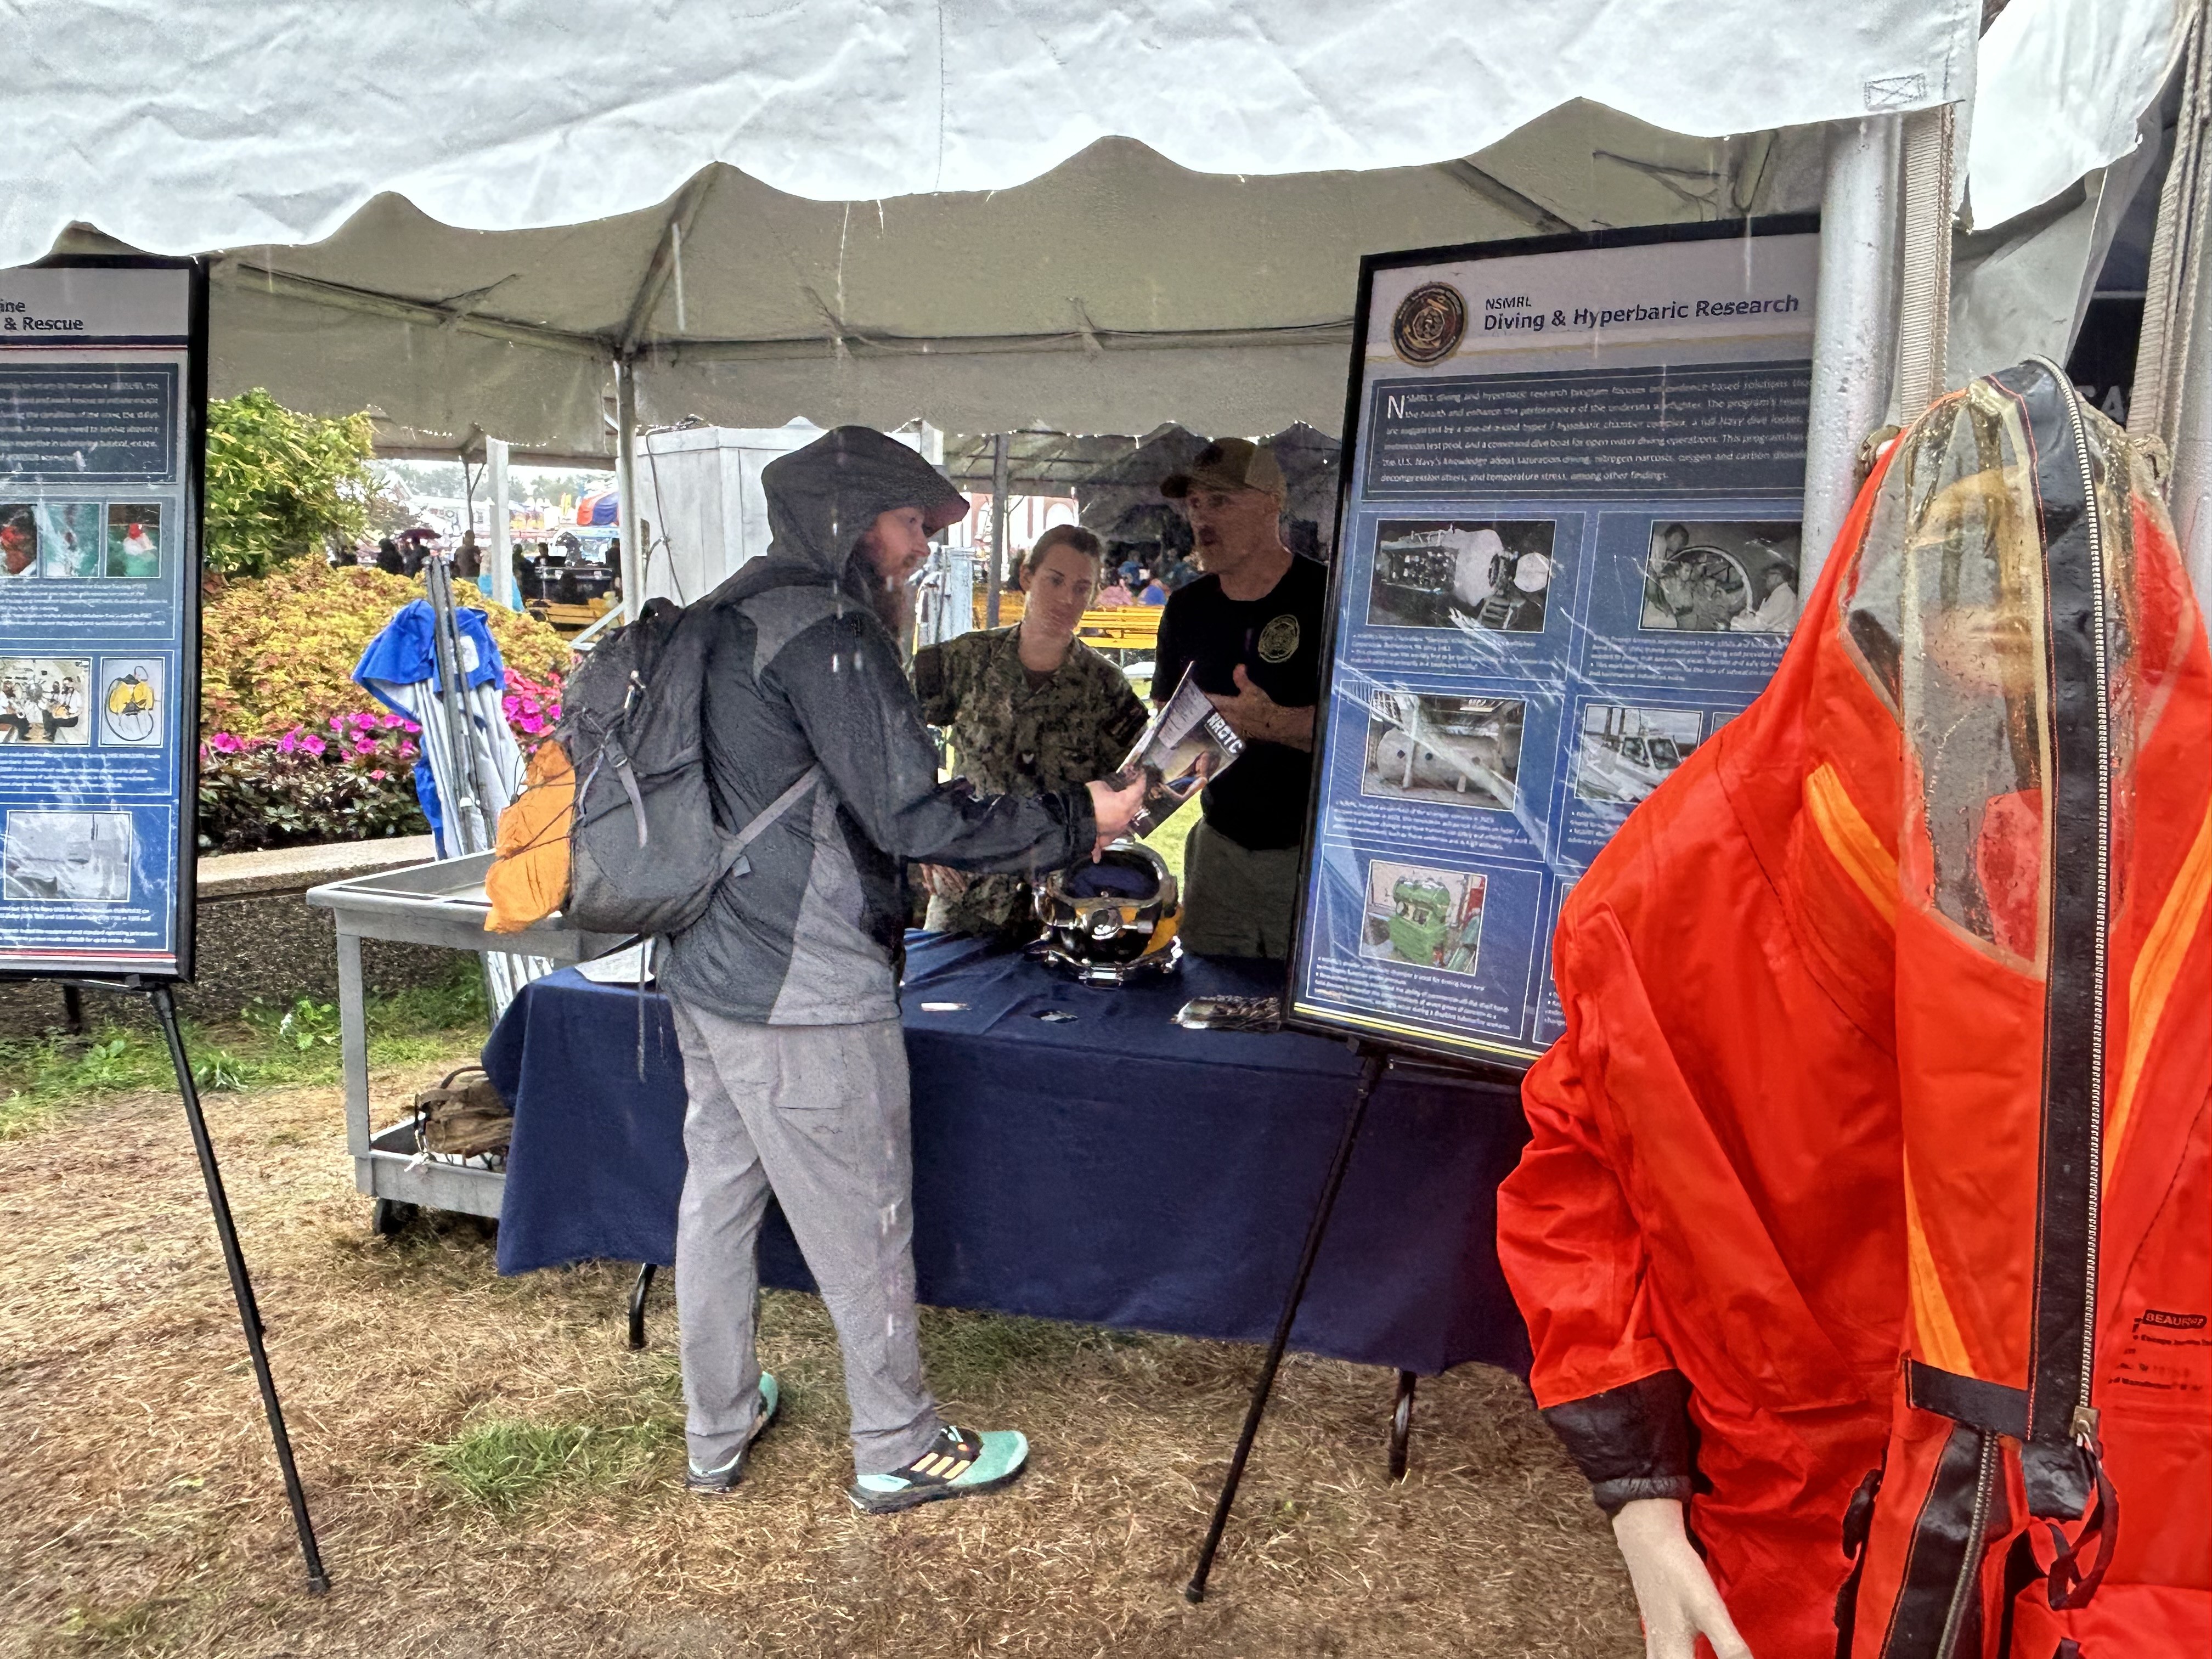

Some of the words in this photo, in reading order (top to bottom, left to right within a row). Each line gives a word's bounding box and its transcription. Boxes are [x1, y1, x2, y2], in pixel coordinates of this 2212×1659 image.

[1484, 312, 1544, 331] Diving
[1551, 309, 1566, 327] &
[1573, 300, 1689, 328] Hyperbaric
[1695, 295, 1799, 317] Research
[1486, 296, 1532, 311] NSMRL
[4, 317, 18, 330] &
[23, 317, 84, 330] Rescue
[1206, 712, 1243, 753] NROTC
